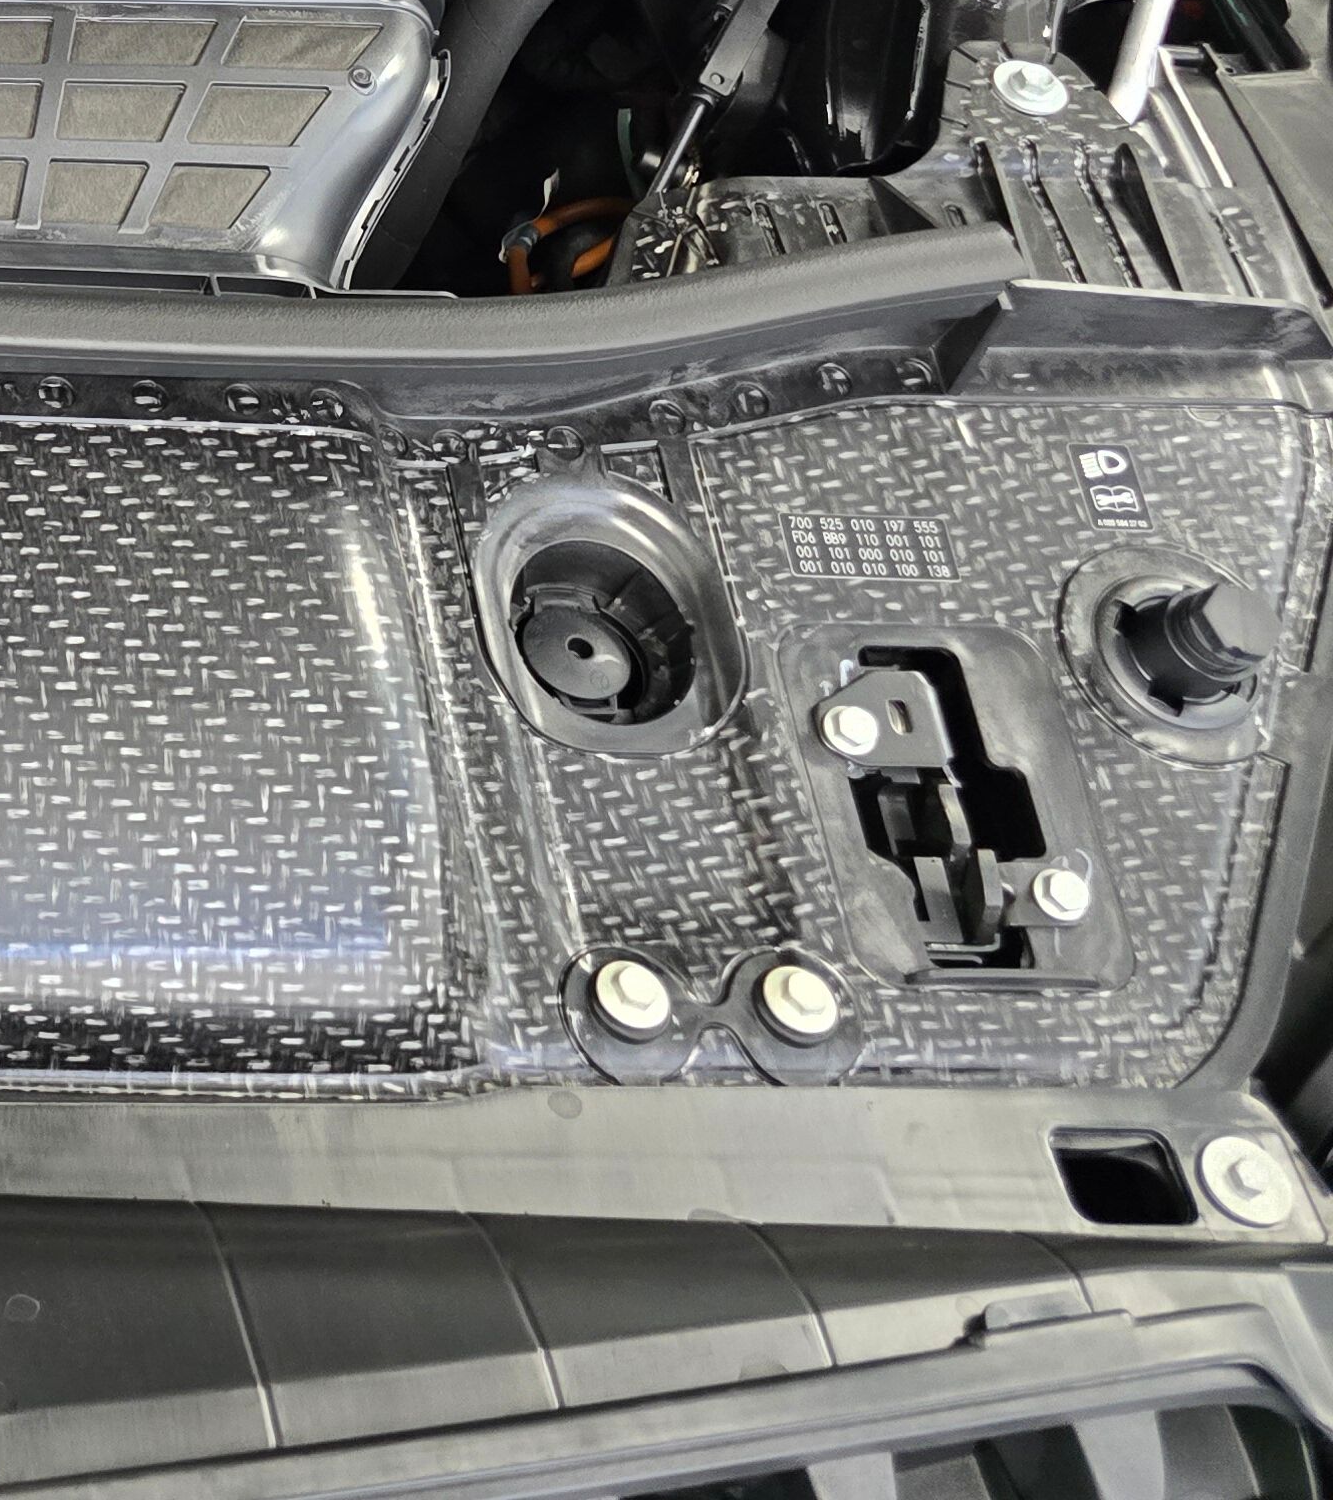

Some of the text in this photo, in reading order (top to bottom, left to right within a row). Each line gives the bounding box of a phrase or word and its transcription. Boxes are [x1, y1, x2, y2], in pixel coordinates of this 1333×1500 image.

[788, 516, 938, 534] 700 525 010 197 555
[792, 531, 816, 544] FD6
[856, 533, 879, 547] 110
[886, 534, 909, 547] 001
[918, 536, 941, 548] 101
[796, 545, 945, 563] 001 101 000 010 101
[800, 560, 950, 578] 001 010 010 100 138
